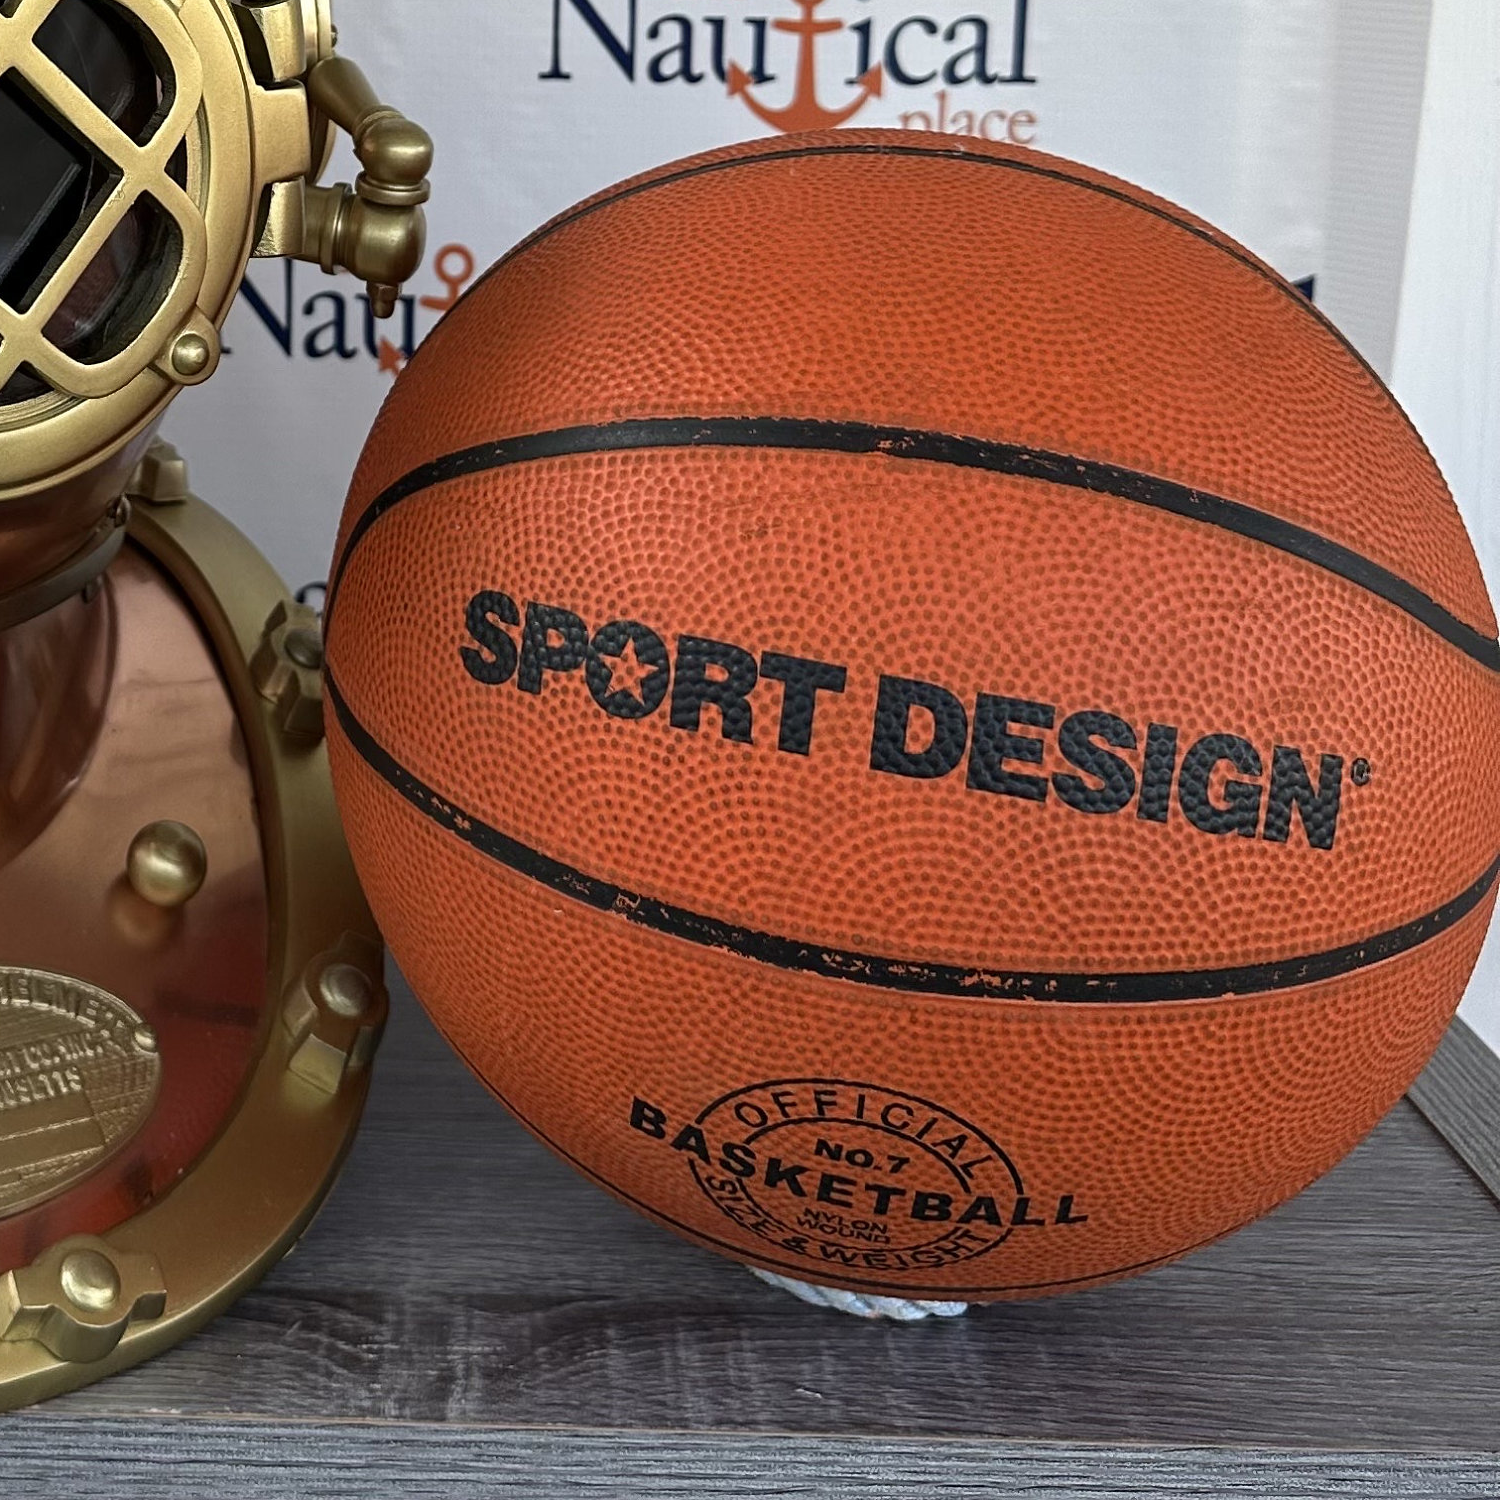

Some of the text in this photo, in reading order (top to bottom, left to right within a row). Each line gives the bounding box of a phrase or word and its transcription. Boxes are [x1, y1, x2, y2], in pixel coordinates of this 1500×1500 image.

[460, 590, 847, 757] SPORT
[630, 1095, 1089, 1228] BASKETBALL
[734, 1089, 993, 1180] OFFICIAL
[815, 1138, 911, 1175] NO.7
[704, 1174, 786, 1238] SIZE
[818, 1226, 991, 1270] WEIGHT
[796, 1219, 891, 1245] WOUND
[803, 1207, 888, 1234] NYLON
